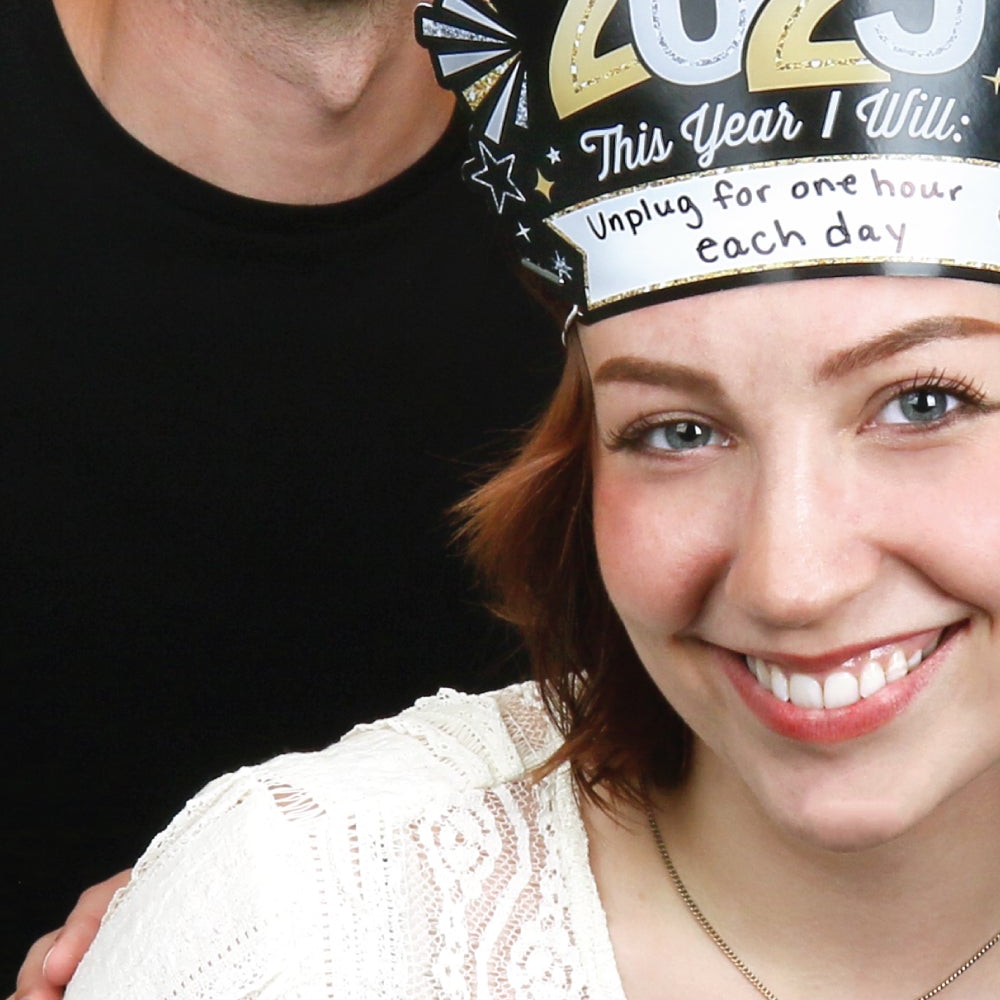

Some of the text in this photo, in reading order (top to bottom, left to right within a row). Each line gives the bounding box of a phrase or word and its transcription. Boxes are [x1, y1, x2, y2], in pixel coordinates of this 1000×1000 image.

[580, 89, 971, 181] This Year I Will:
[586, 167, 964, 242] Unplug for one hour
[695, 211, 909, 266] each day
